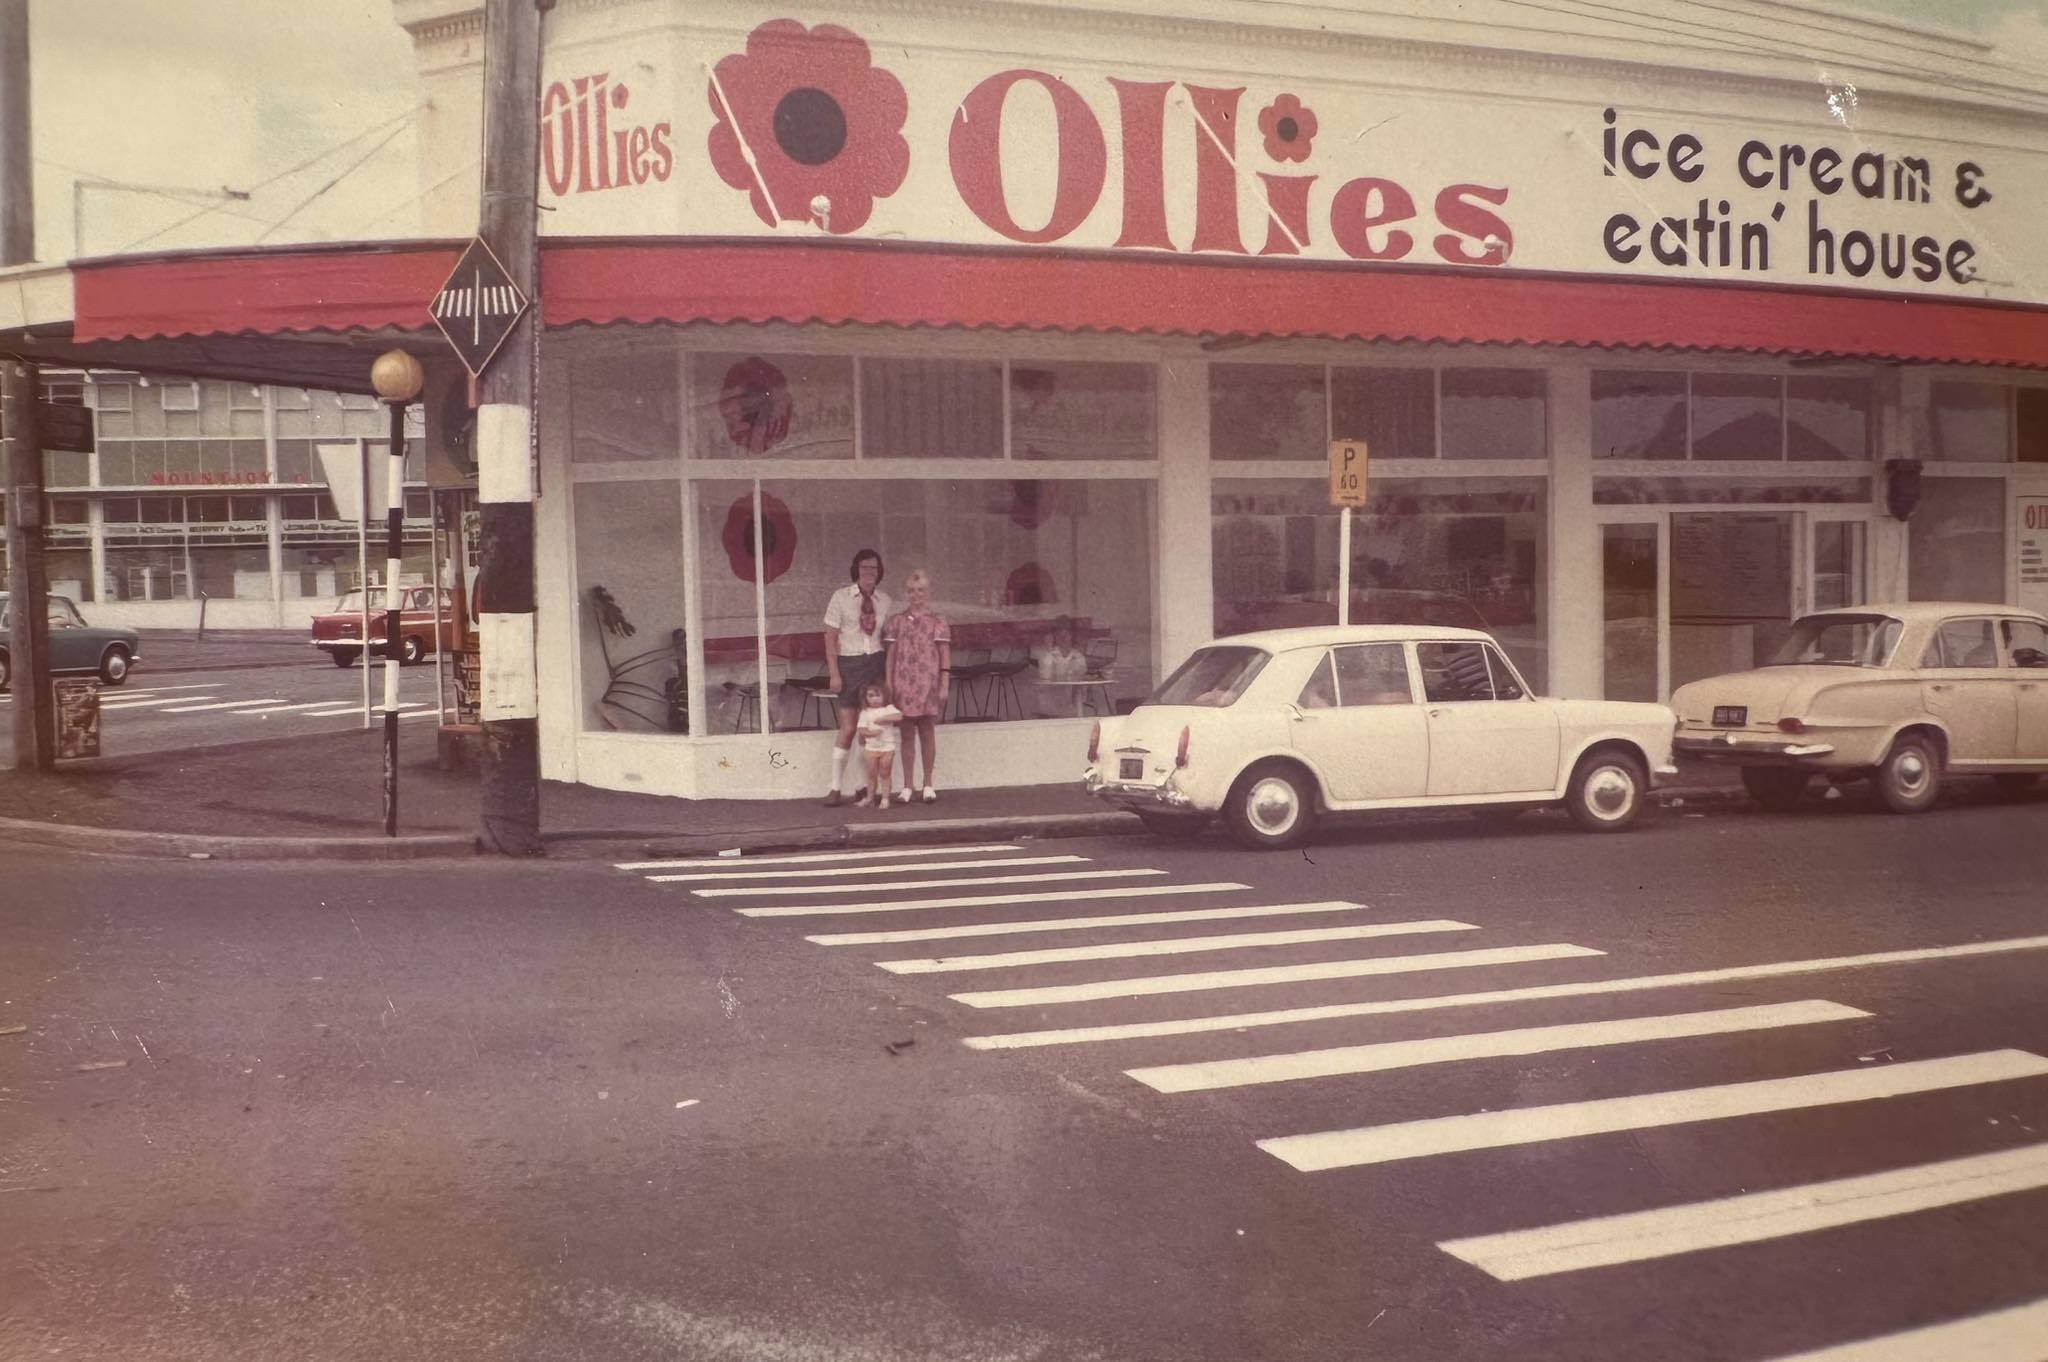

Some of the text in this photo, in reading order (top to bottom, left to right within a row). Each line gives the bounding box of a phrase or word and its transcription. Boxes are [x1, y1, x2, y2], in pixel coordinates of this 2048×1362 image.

[541, 73, 673, 197] Ollies
[948, 68, 1514, 266] Ollies
[1603, 107, 1993, 209] ice cream &
[1603, 198, 1977, 284] eatin' house
[1344, 447, 1356, 471] P
